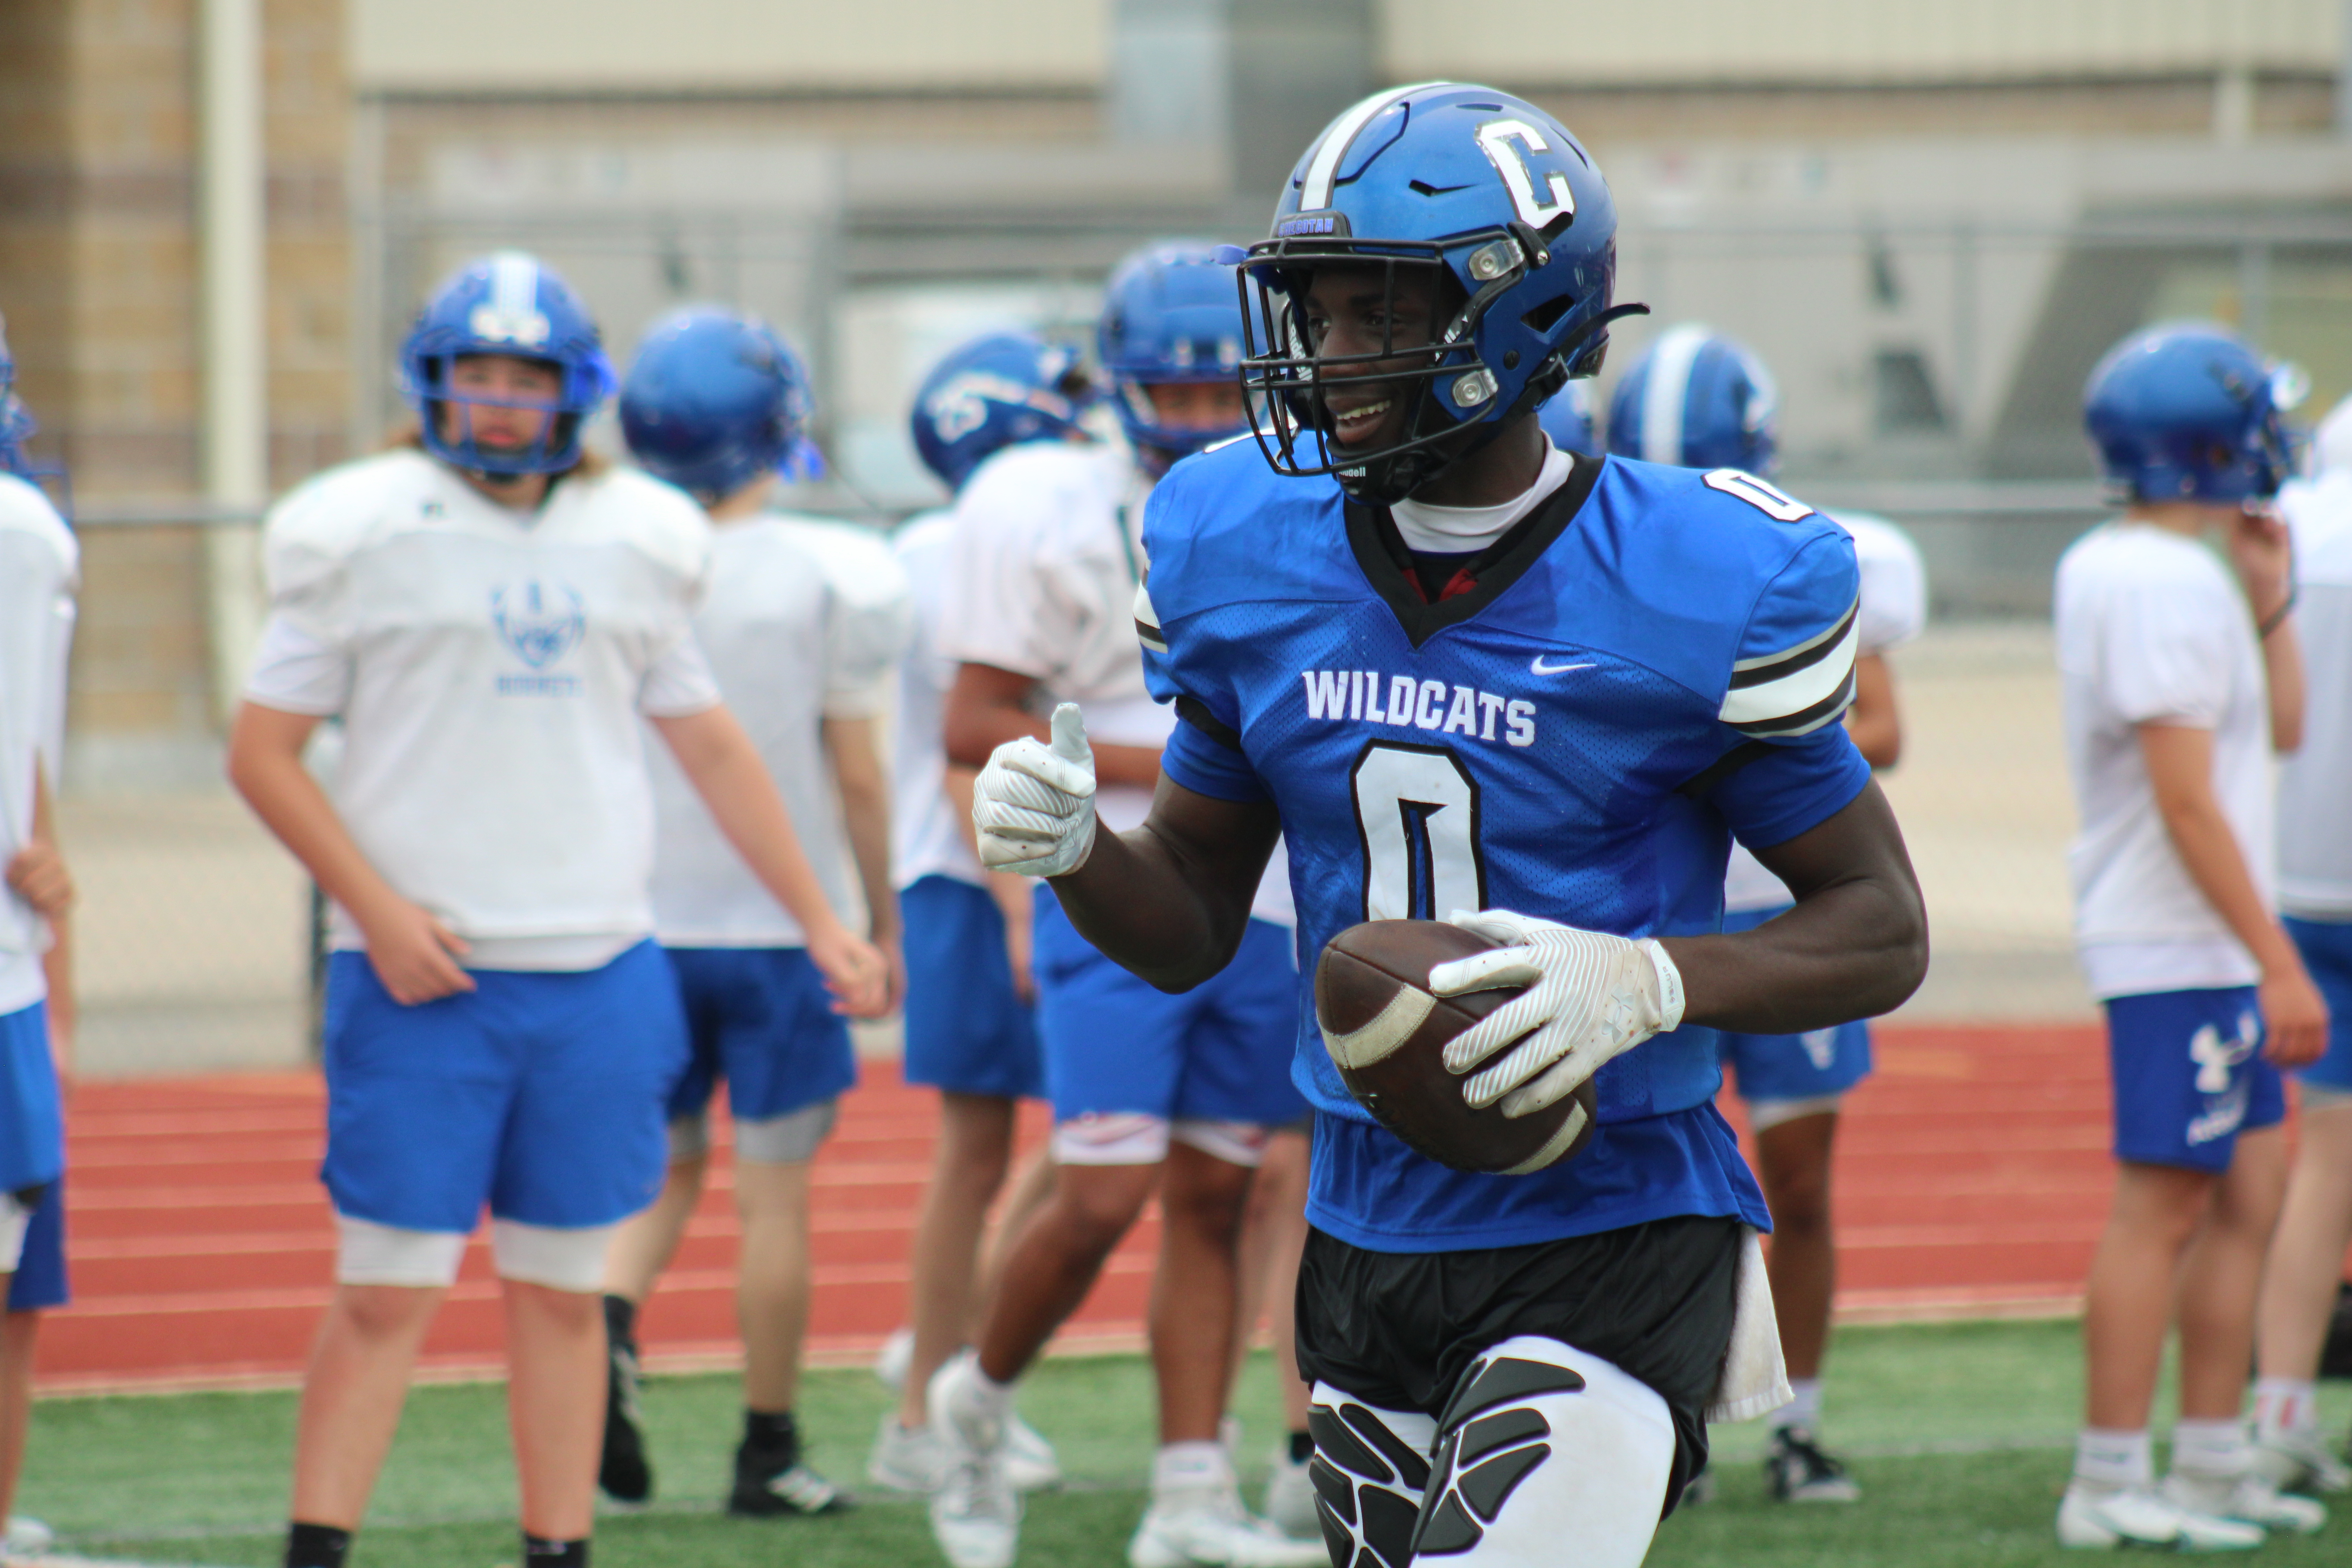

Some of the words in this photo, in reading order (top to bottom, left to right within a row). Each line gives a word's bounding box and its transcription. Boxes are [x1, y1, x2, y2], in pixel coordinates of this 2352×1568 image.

[1474, 120, 1577, 230] C
[1278, 218, 1333, 237] CHECOTAH
[1302, 670, 1536, 747] WILDCATS
[1662, 965, 1675, 996] BLUR
